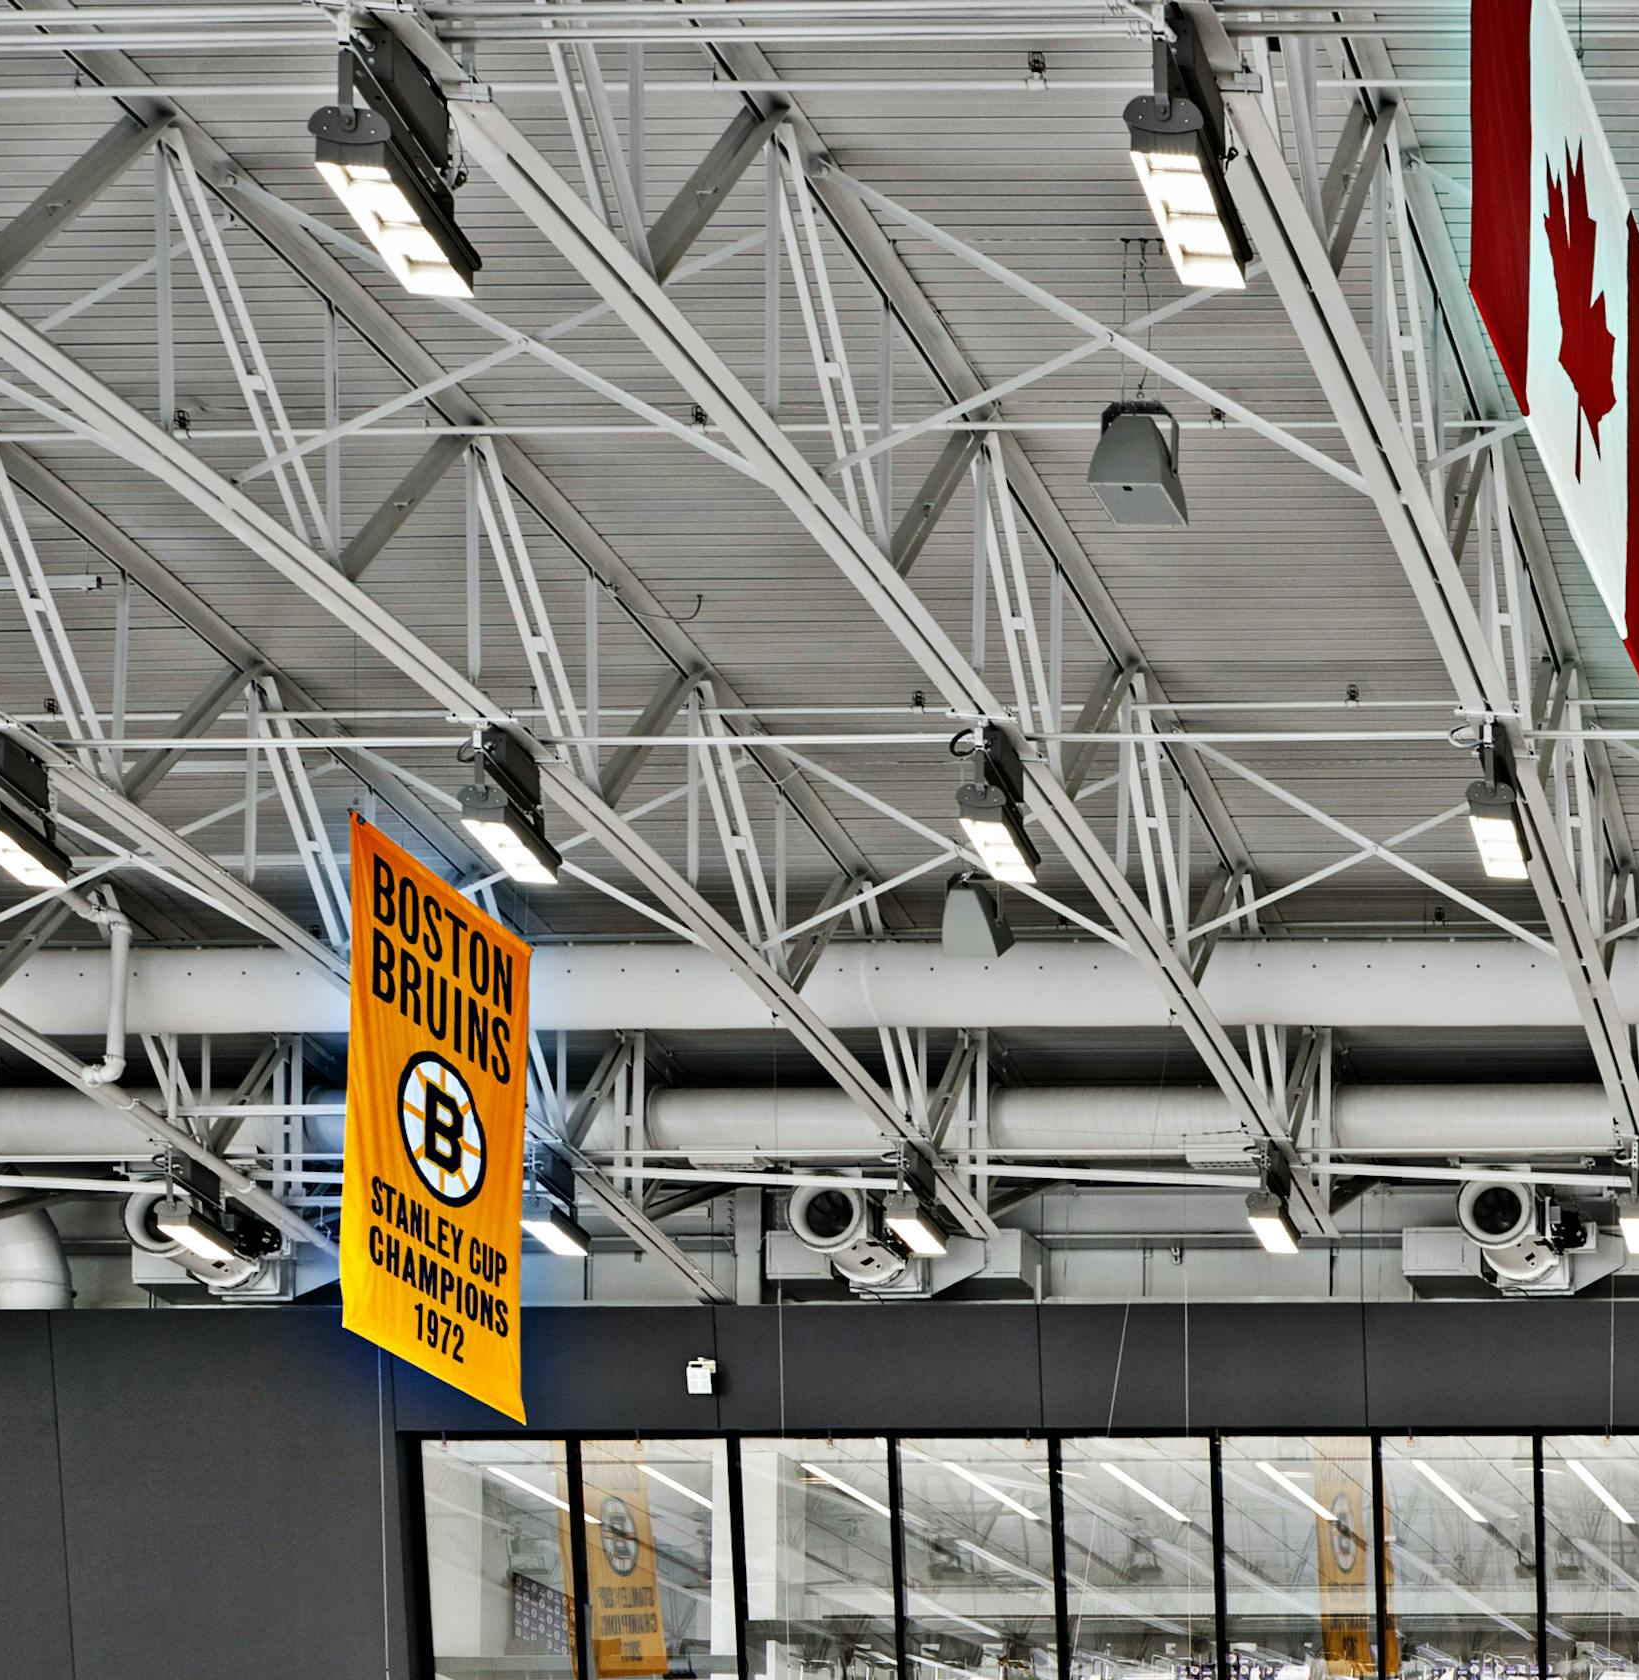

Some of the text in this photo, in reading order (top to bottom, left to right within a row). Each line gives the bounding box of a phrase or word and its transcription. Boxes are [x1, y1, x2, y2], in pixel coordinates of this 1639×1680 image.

[373, 853, 513, 1016] BOSTON
[372, 928, 511, 1085] BRUINS
[369, 1226, 509, 1337] CHAMPIONS
[371, 1176, 508, 1287] STANLEY CUP
[414, 1303, 465, 1364] 1972
